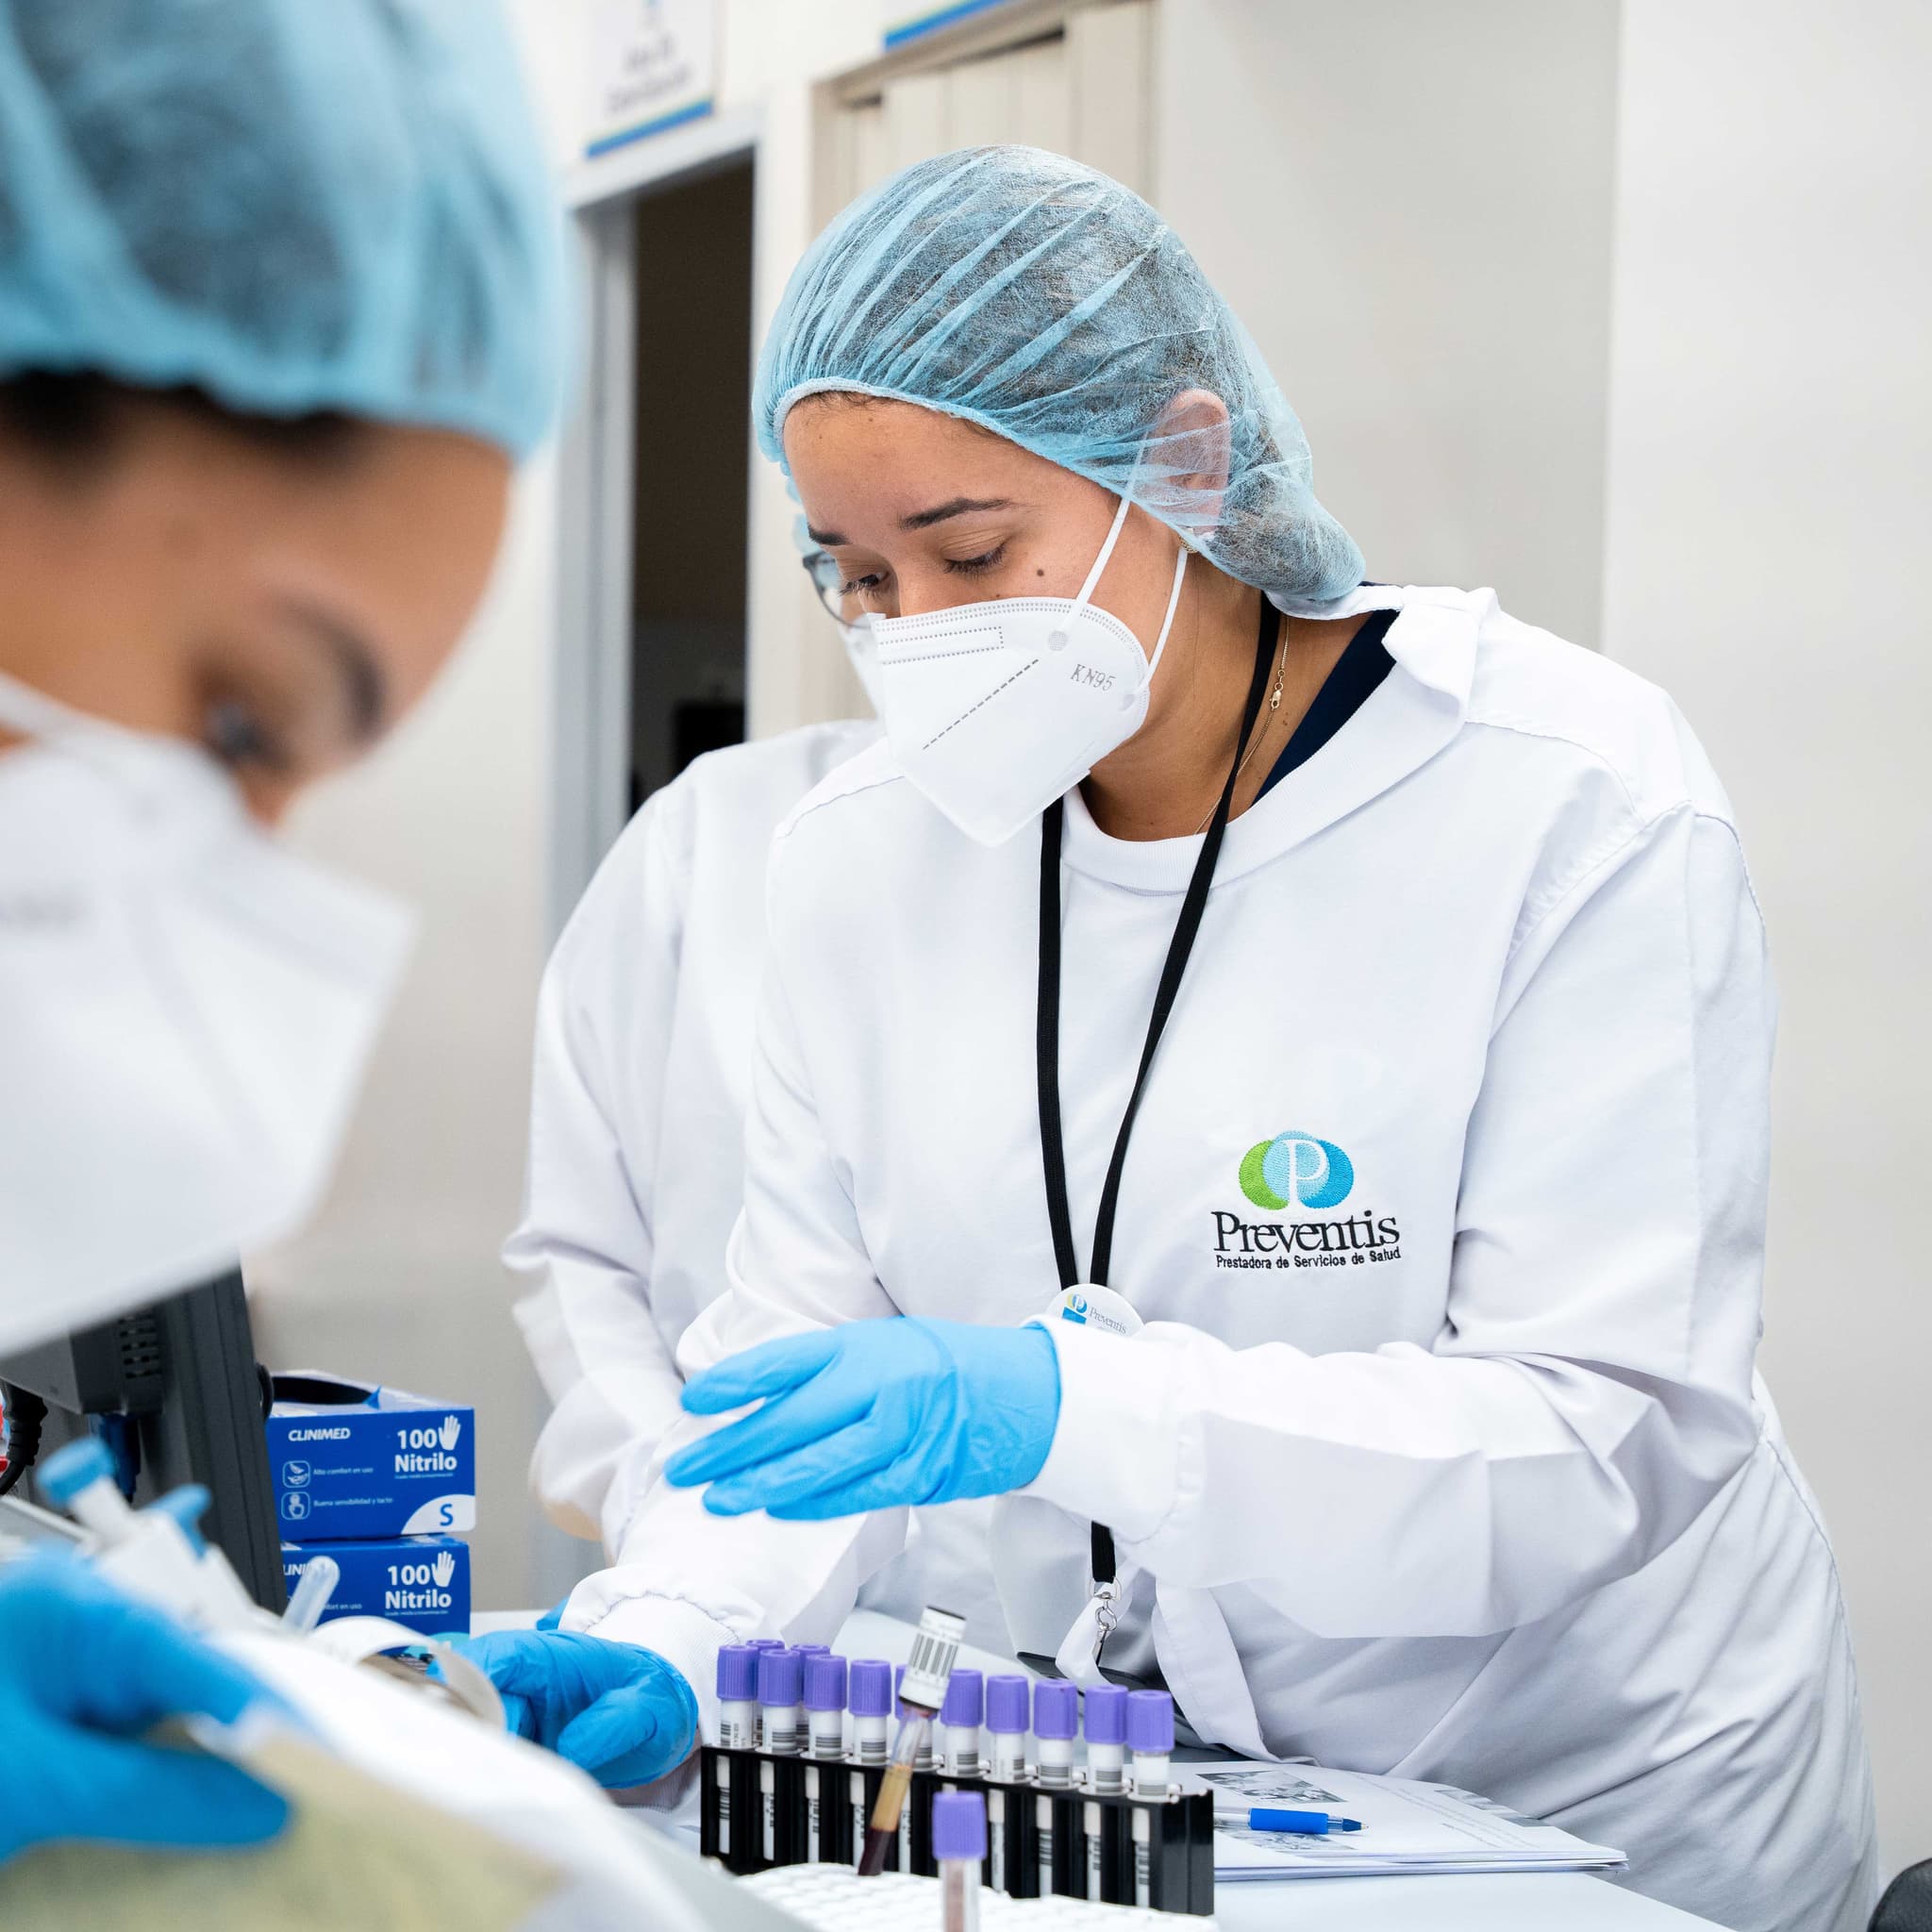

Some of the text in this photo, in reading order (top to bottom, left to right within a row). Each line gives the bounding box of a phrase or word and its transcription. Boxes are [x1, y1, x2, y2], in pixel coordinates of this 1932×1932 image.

[1071, 663, 1116, 691] KN95
[1210, 1209, 1400, 1254] Preventis
[1215, 1246, 1402, 1270] Prestadora de Servicios de Salud
[1089, 1306, 1127, 1334] Preventis
[288, 1427, 351, 1442] CLINIMED
[397, 1428, 438, 1449] 100
[394, 1452, 458, 1473] Nitrilo
[440, 1504, 454, 1526] S
[388, 1564, 431, 1586] 100
[385, 1589, 453, 1609] Nitrilo
